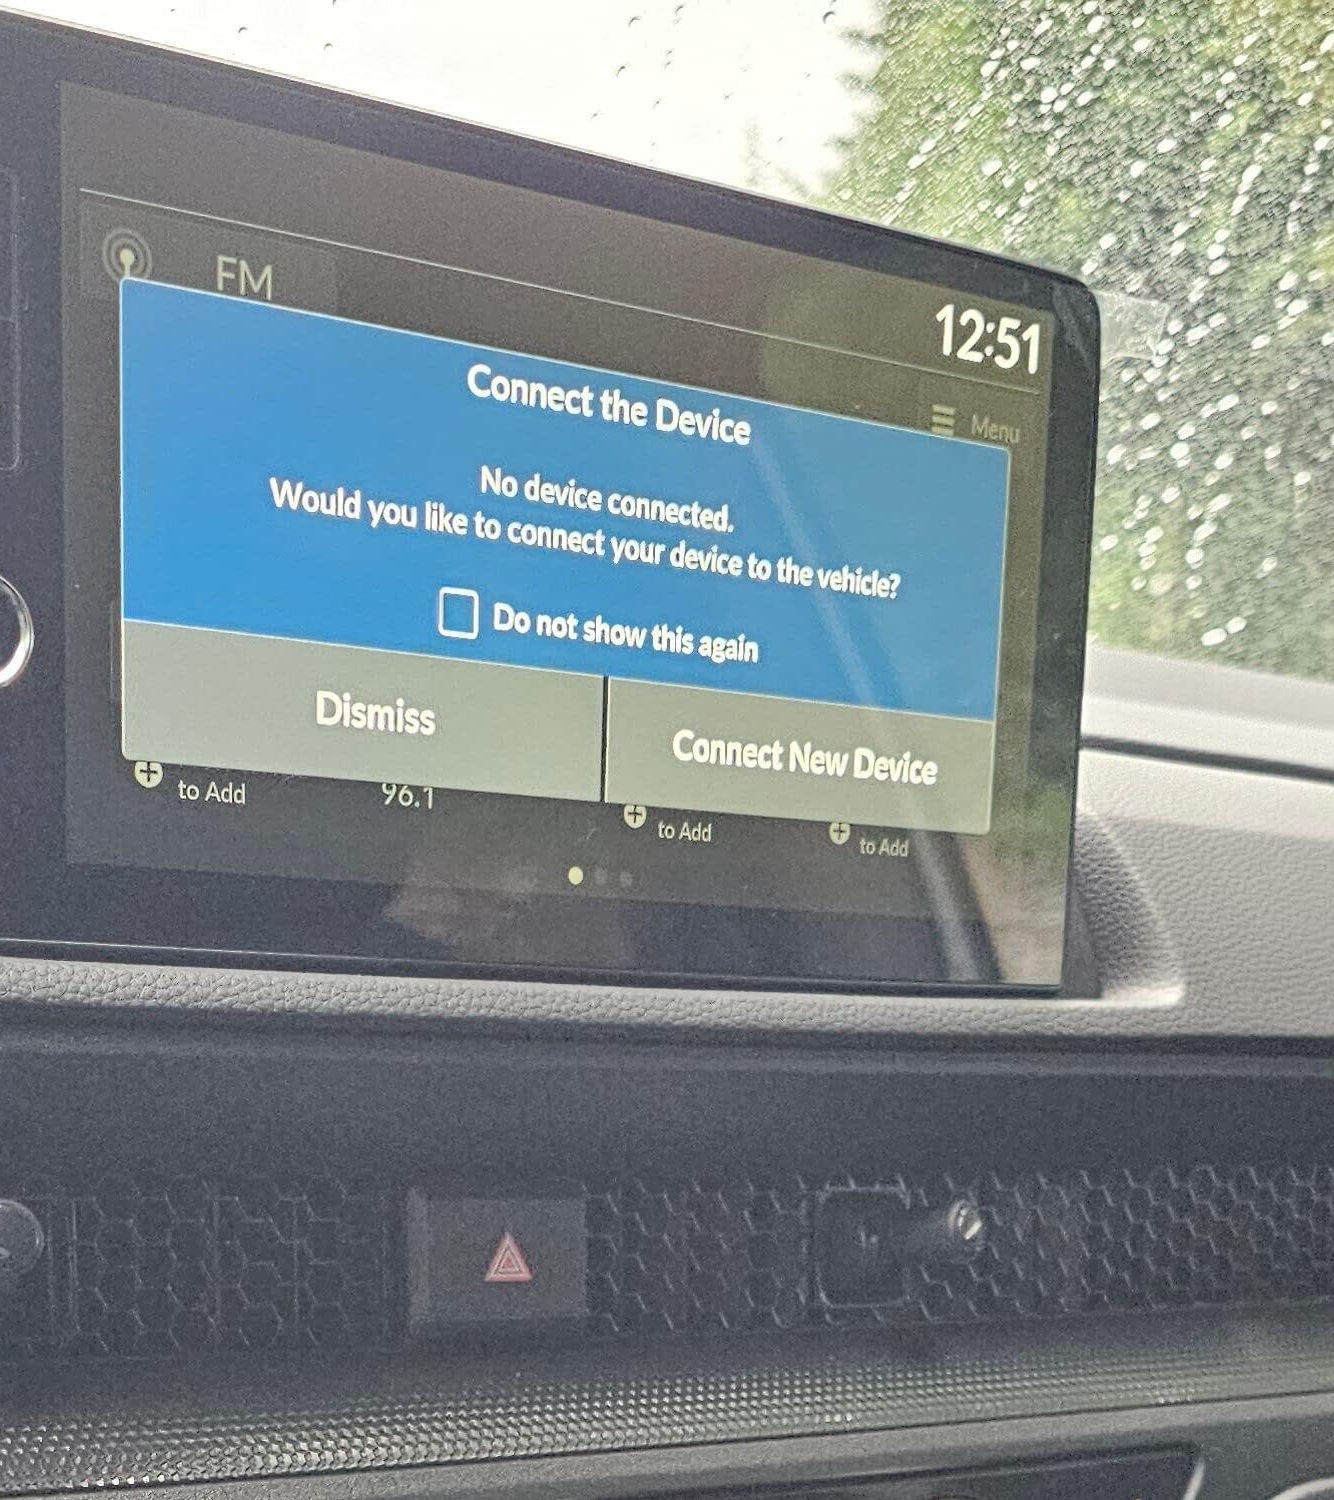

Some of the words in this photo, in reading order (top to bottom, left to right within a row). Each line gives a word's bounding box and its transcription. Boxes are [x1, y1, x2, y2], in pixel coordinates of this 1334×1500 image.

[216, 256, 273, 299] FM
[935, 303, 1041, 375] 12:51
[467, 363, 594, 418] Connect
[600, 389, 648, 427] the
[656, 398, 752, 446] Device
[970, 414, 1021, 444] Menu
[480, 465, 518, 498] No
[524, 473, 602, 512] device
[607, 493, 735, 533] connected.
[269, 477, 362, 520] Would
[367, 500, 417, 528] you
[425, 500, 468, 535] like
[474, 510, 501, 540] to
[507, 520, 606, 556] connect
[610, 536, 666, 564] your
[670, 540, 743, 577] device
[747, 553, 772, 581] to
[776, 556, 814, 587] the
[817, 565, 901, 600] vehicle?
[493, 602, 531, 634] Do
[536, 613, 579, 640] not
[583, 615, 646, 650] show
[652, 624, 694, 656] this
[698, 634, 759, 665] again
[315, 690, 436, 737] Dismiss
[672, 729, 783, 771] Connect
[789, 740, 849, 777] New
[853, 746, 938, 785] Device
[177, 780, 200, 802] to
[204, 782, 247, 805] Add
[381, 782, 434, 810] 96.1
[658, 821, 675, 840] to
[678, 822, 712, 843] Add
[860, 838, 876, 855] to
[879, 838, 909, 857] Add
